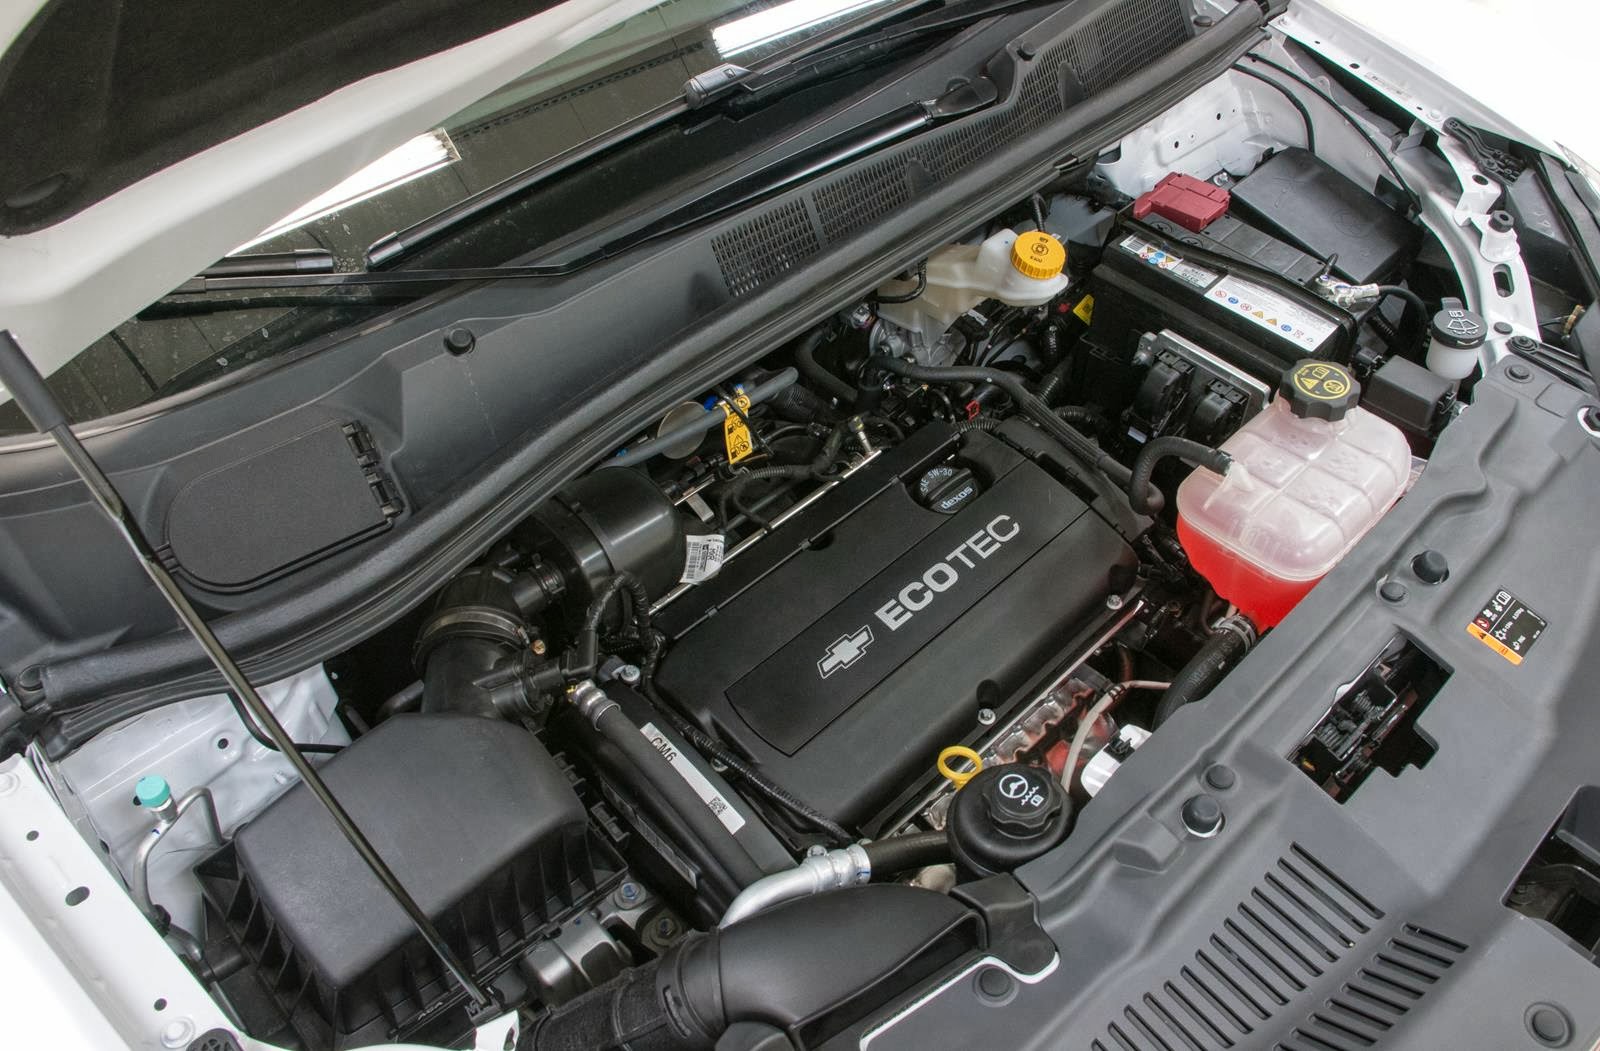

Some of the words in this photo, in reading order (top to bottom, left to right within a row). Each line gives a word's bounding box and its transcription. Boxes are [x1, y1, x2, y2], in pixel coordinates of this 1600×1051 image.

[920, 479, 929, 495] SAE
[928, 467, 953, 479] 5W-30
[941, 486, 973, 509] dexos
[874, 514, 1020, 631] ECOTEC
[651, 737, 677, 761] CM6
